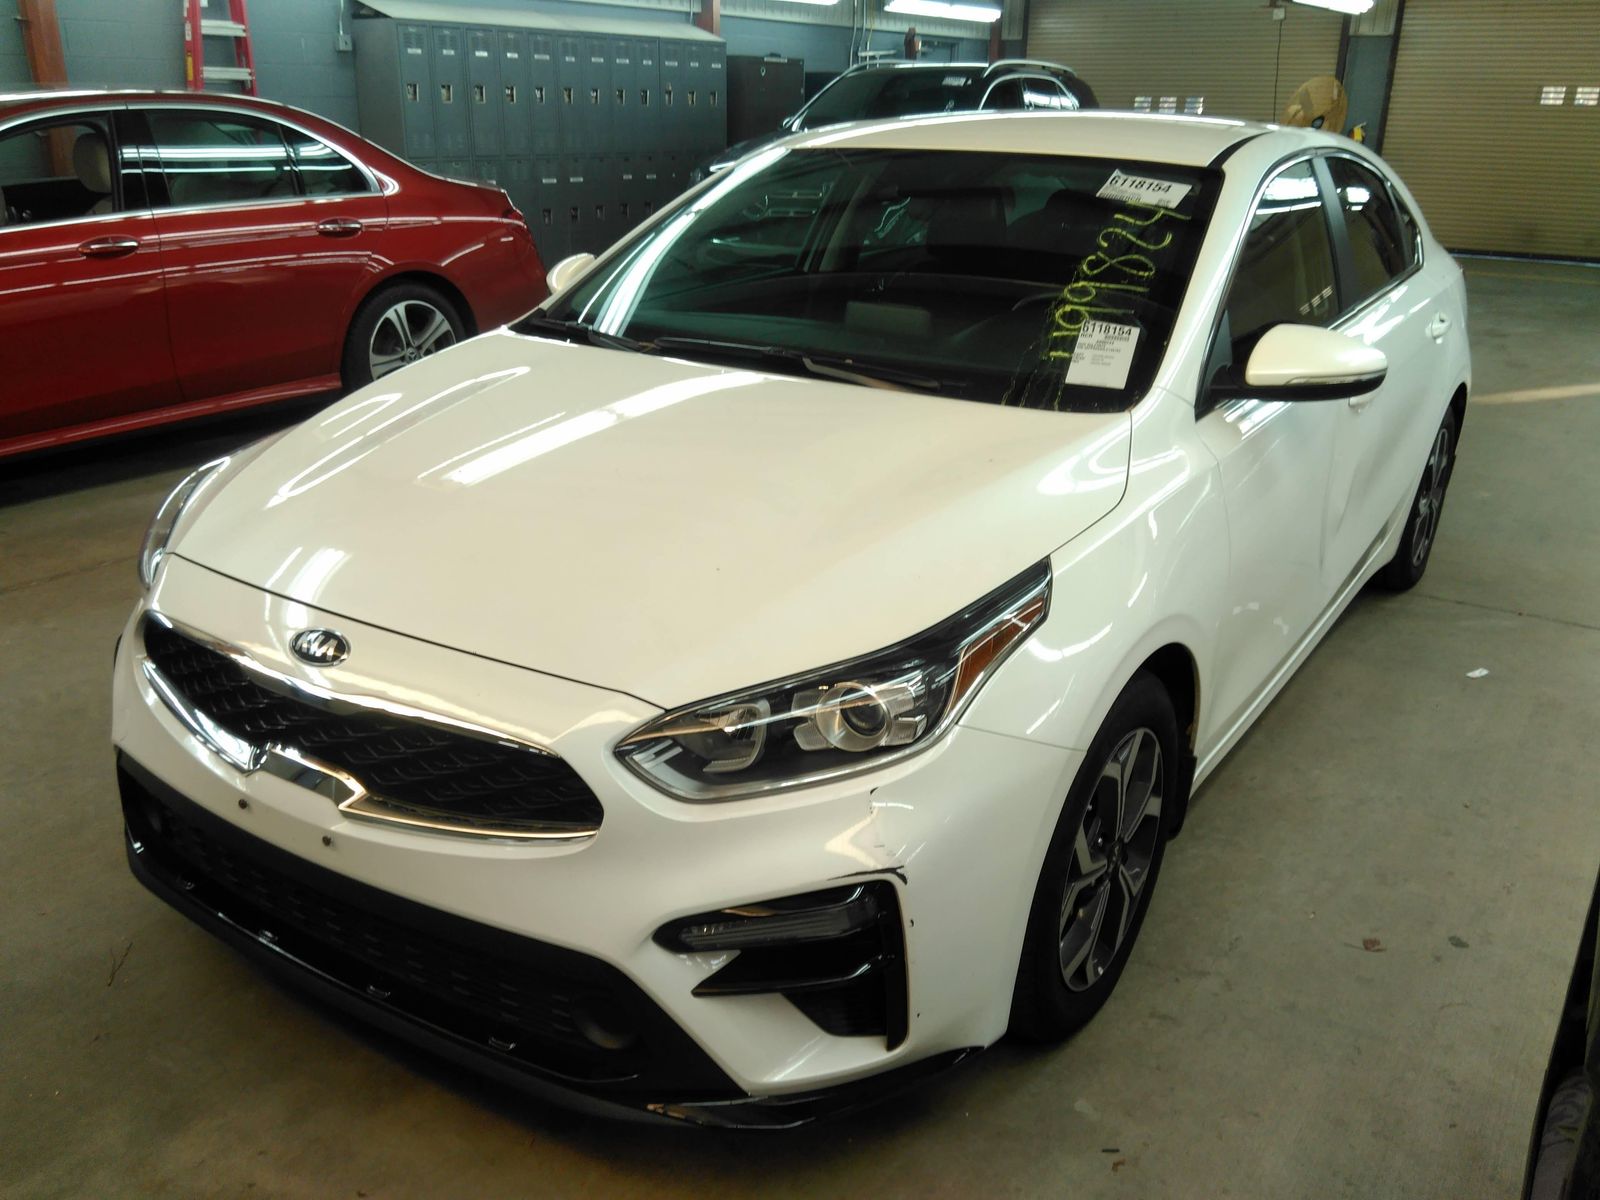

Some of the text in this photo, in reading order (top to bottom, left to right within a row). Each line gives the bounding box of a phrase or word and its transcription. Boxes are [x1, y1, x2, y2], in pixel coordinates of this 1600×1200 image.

[1109, 175, 1172, 193] 6118154
[1082, 319, 1132, 336] 6118154
[294, 631, 338, 661] KIA
